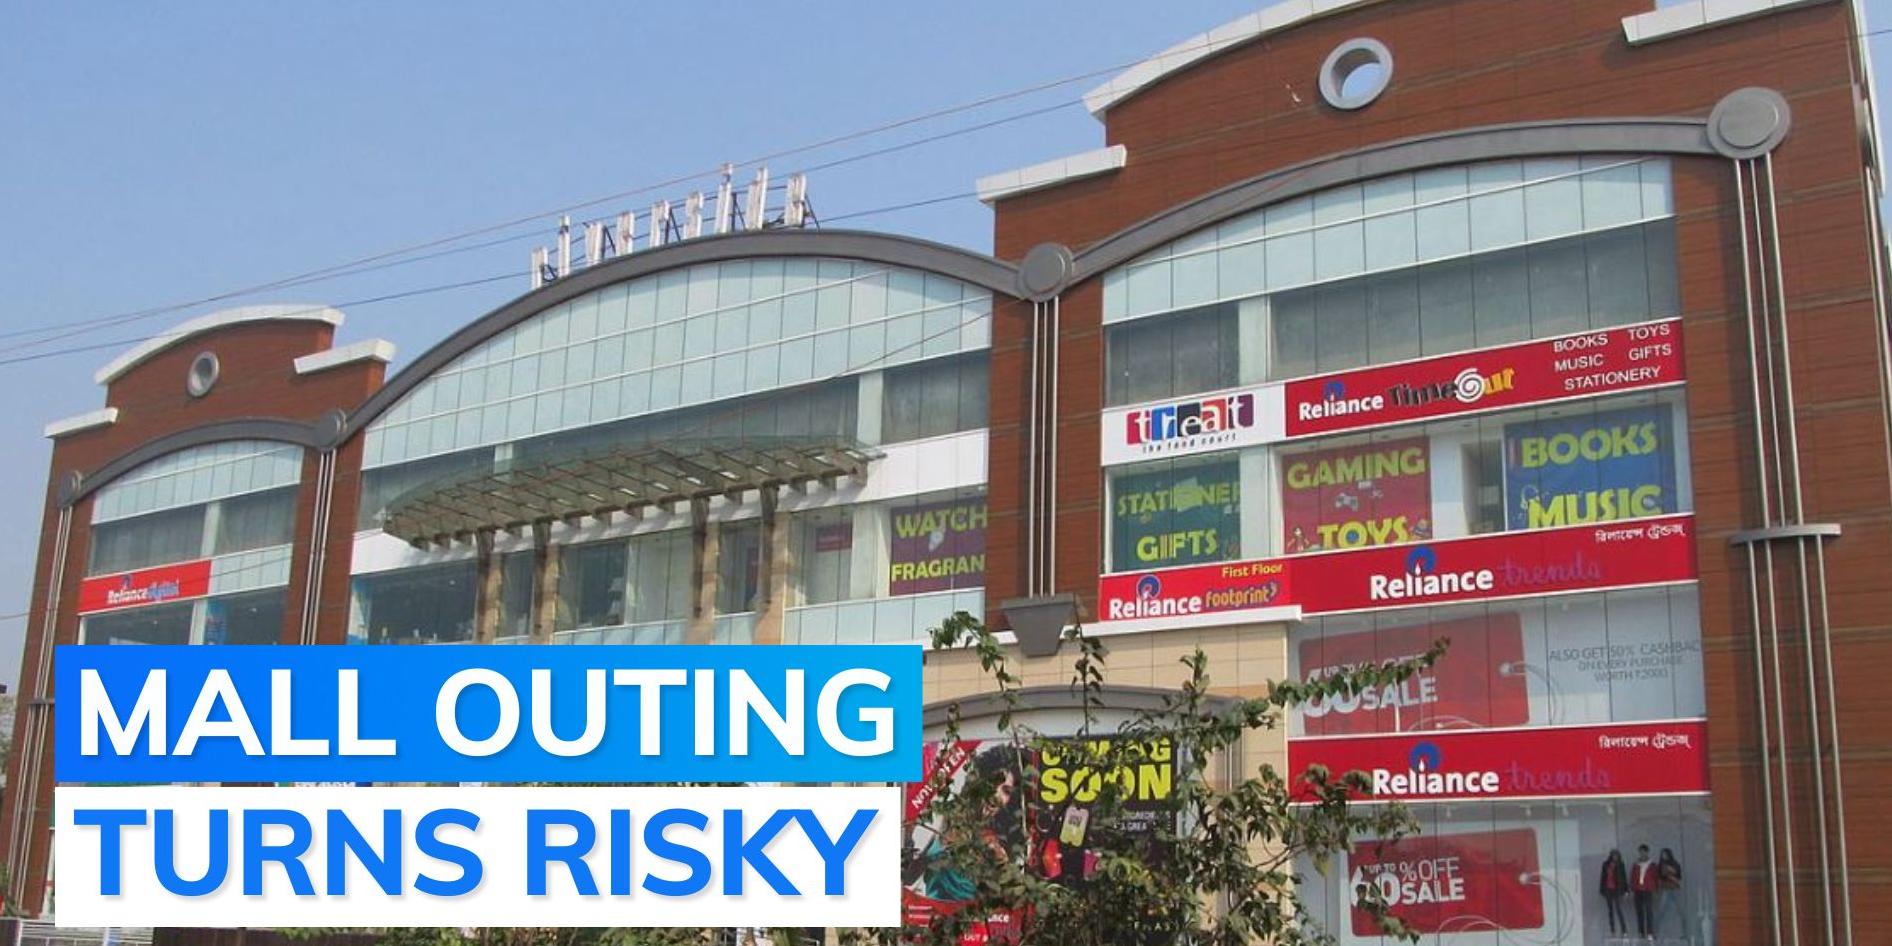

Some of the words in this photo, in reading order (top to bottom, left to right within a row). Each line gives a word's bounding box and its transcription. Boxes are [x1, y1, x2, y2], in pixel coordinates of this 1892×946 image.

[1553, 333, 1608, 353] BOOKS
[1628, 323, 1670, 340] TOYS
[1554, 354, 1604, 372] MUSIC
[1628, 343, 1672, 361] GIFTS
[1564, 365, 1661, 390] STATIONERY
[1127, 394, 1254, 445] treat
[1299, 391, 1384, 421] Reliance
[1521, 421, 1657, 468] BOOKS
[1287, 448, 1426, 489] GAMING
[896, 504, 986, 539] WATCH
[1528, 485, 1662, 528] MUSIC
[1136, 528, 1218, 562] GIFTS
[1317, 515, 1409, 550] TOYS
[892, 553, 985, 582] FRAGRAN
[1222, 566, 1250, 578] First
[1252, 563, 1283, 577] Floor
[1369, 564, 1494, 600] Reliance
[1501, 552, 1601, 588] trends
[1109, 593, 1202, 619] Reliance
[1205, 585, 1270, 609] footprint
[1582, 645, 1605, 660] GET
[1361, 675, 1438, 711] SALE
[1372, 760, 1499, 795] Reliance
[1506, 757, 1610, 790] trends
[1402, 877, 1466, 905] SALE
